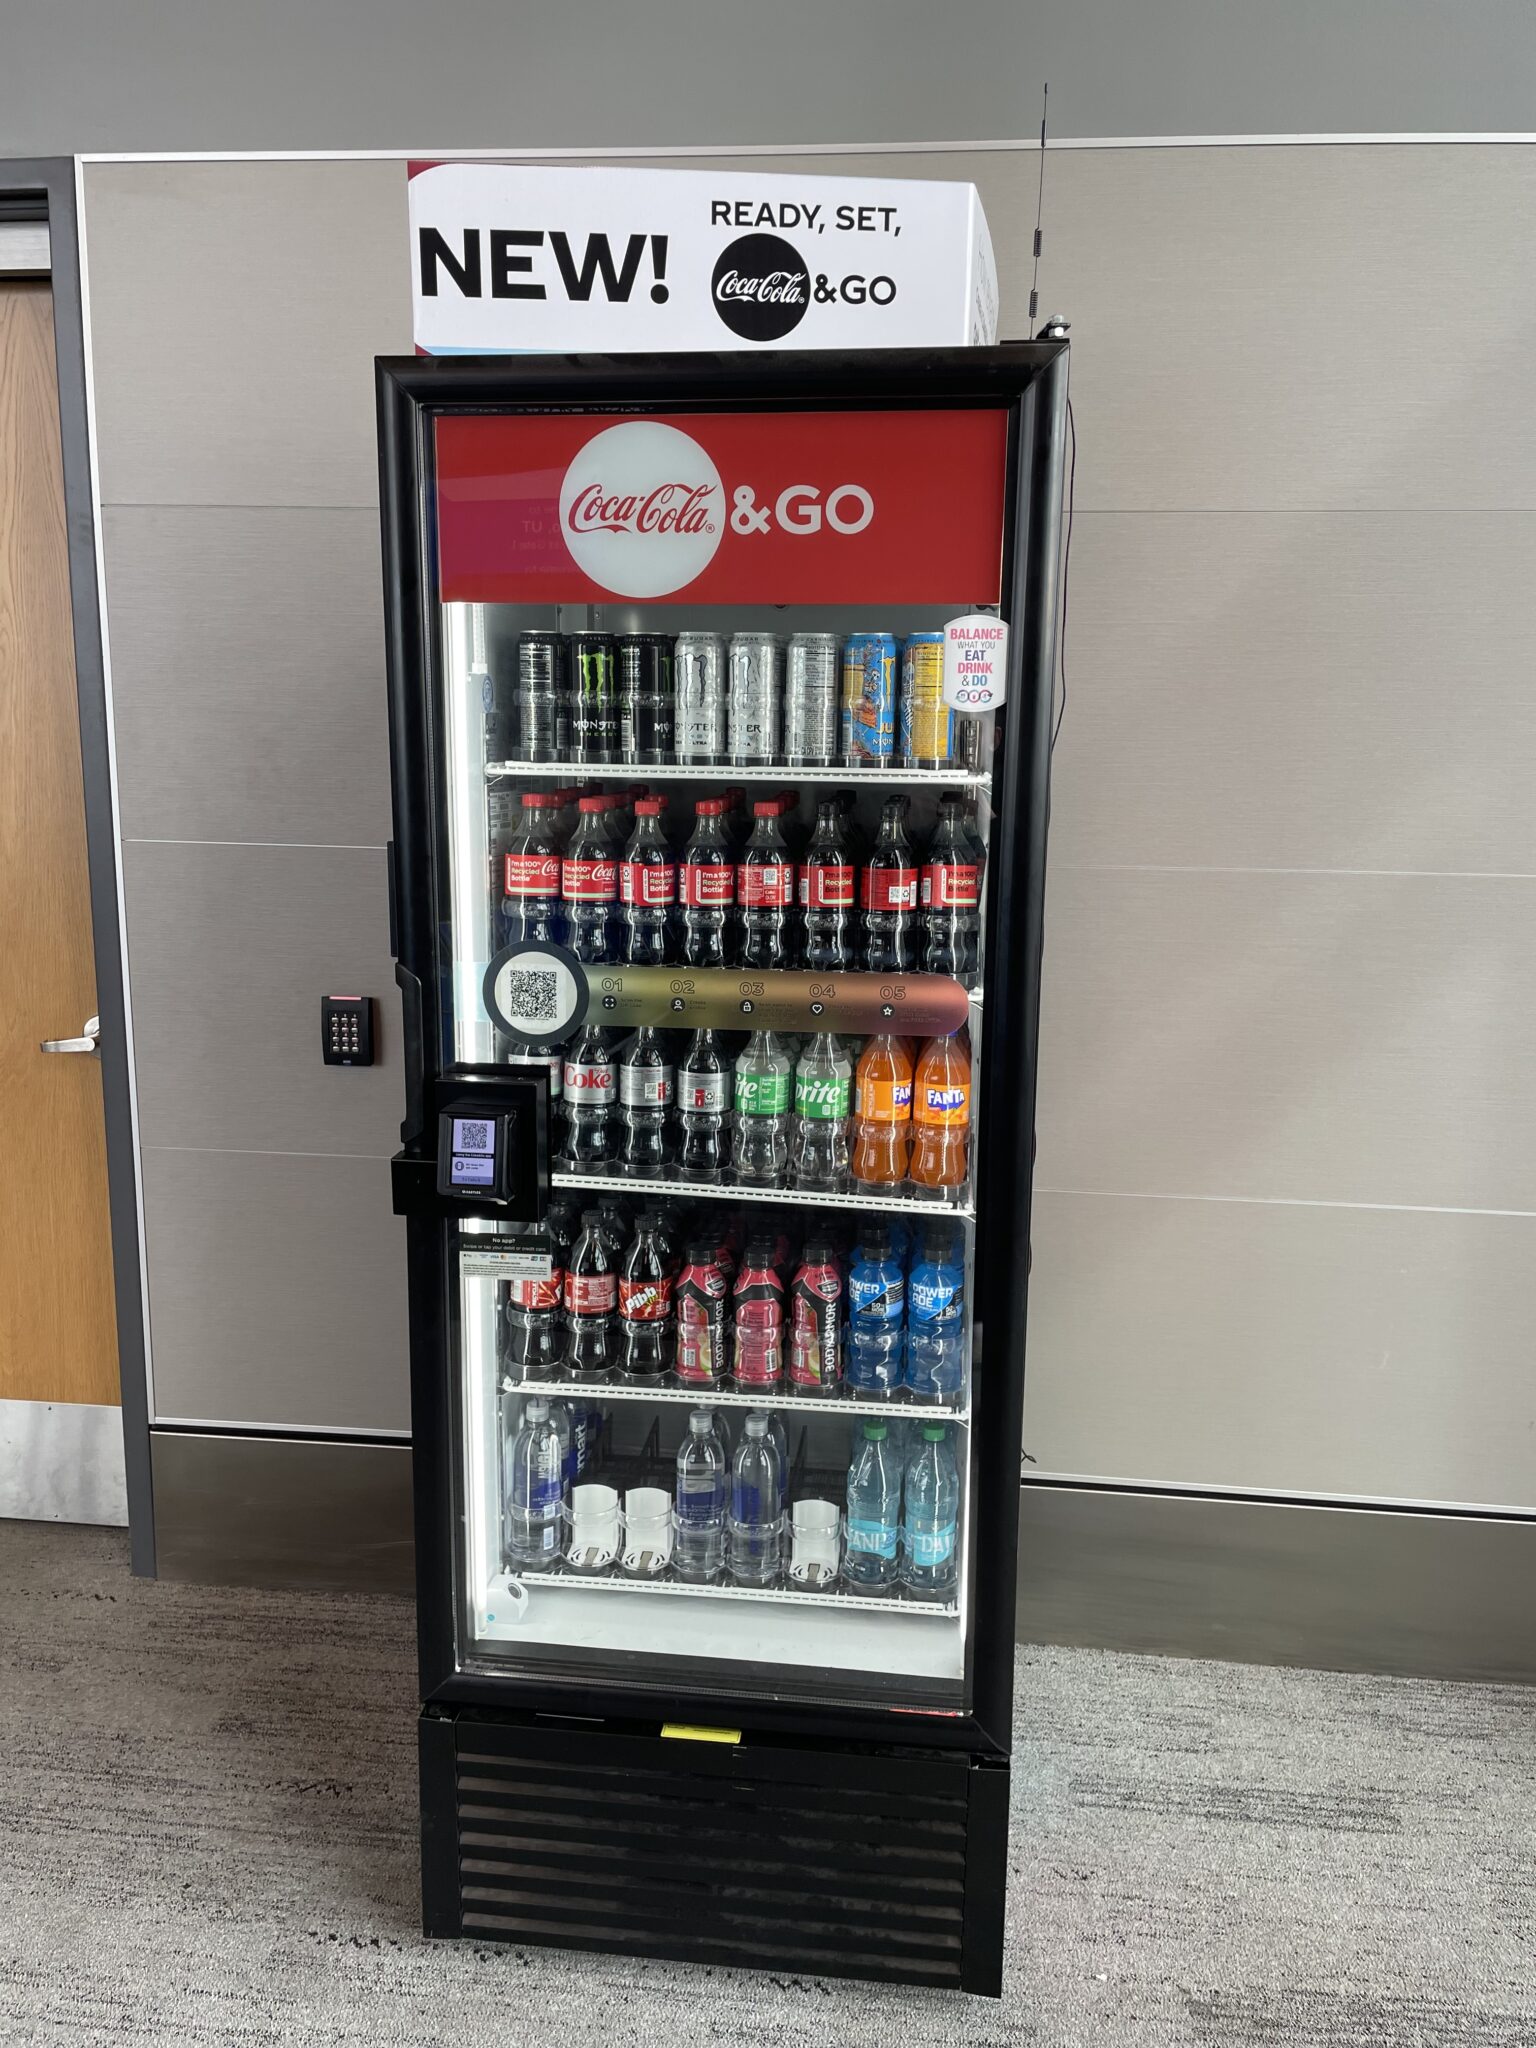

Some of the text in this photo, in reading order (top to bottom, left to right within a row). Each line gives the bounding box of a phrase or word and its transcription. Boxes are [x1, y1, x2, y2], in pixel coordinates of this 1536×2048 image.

[711, 200, 901, 237] READY, SET,
[419, 226, 669, 304] NEW!
[950, 628, 1003, 640] BALANCE
[957, 641, 995, 649] WHAT YOU
[957, 662, 992, 674] DRINK
[961, 675, 987, 686] & DO
[572, 719, 618, 731] MONSTE
[511, 868, 540, 876] Recycled
[601, 977, 623, 992] 01
[670, 979, 695, 994] 02
[739, 982, 764, 996] 03
[809, 984, 836, 998] 04
[880, 985, 906, 1000] 05
[565, 1066, 612, 1089] Coke
[893, 1083, 912, 1102] FAN
[927, 1089, 965, 1104] FANTA
[912, 1283, 953, 1299] POWER
